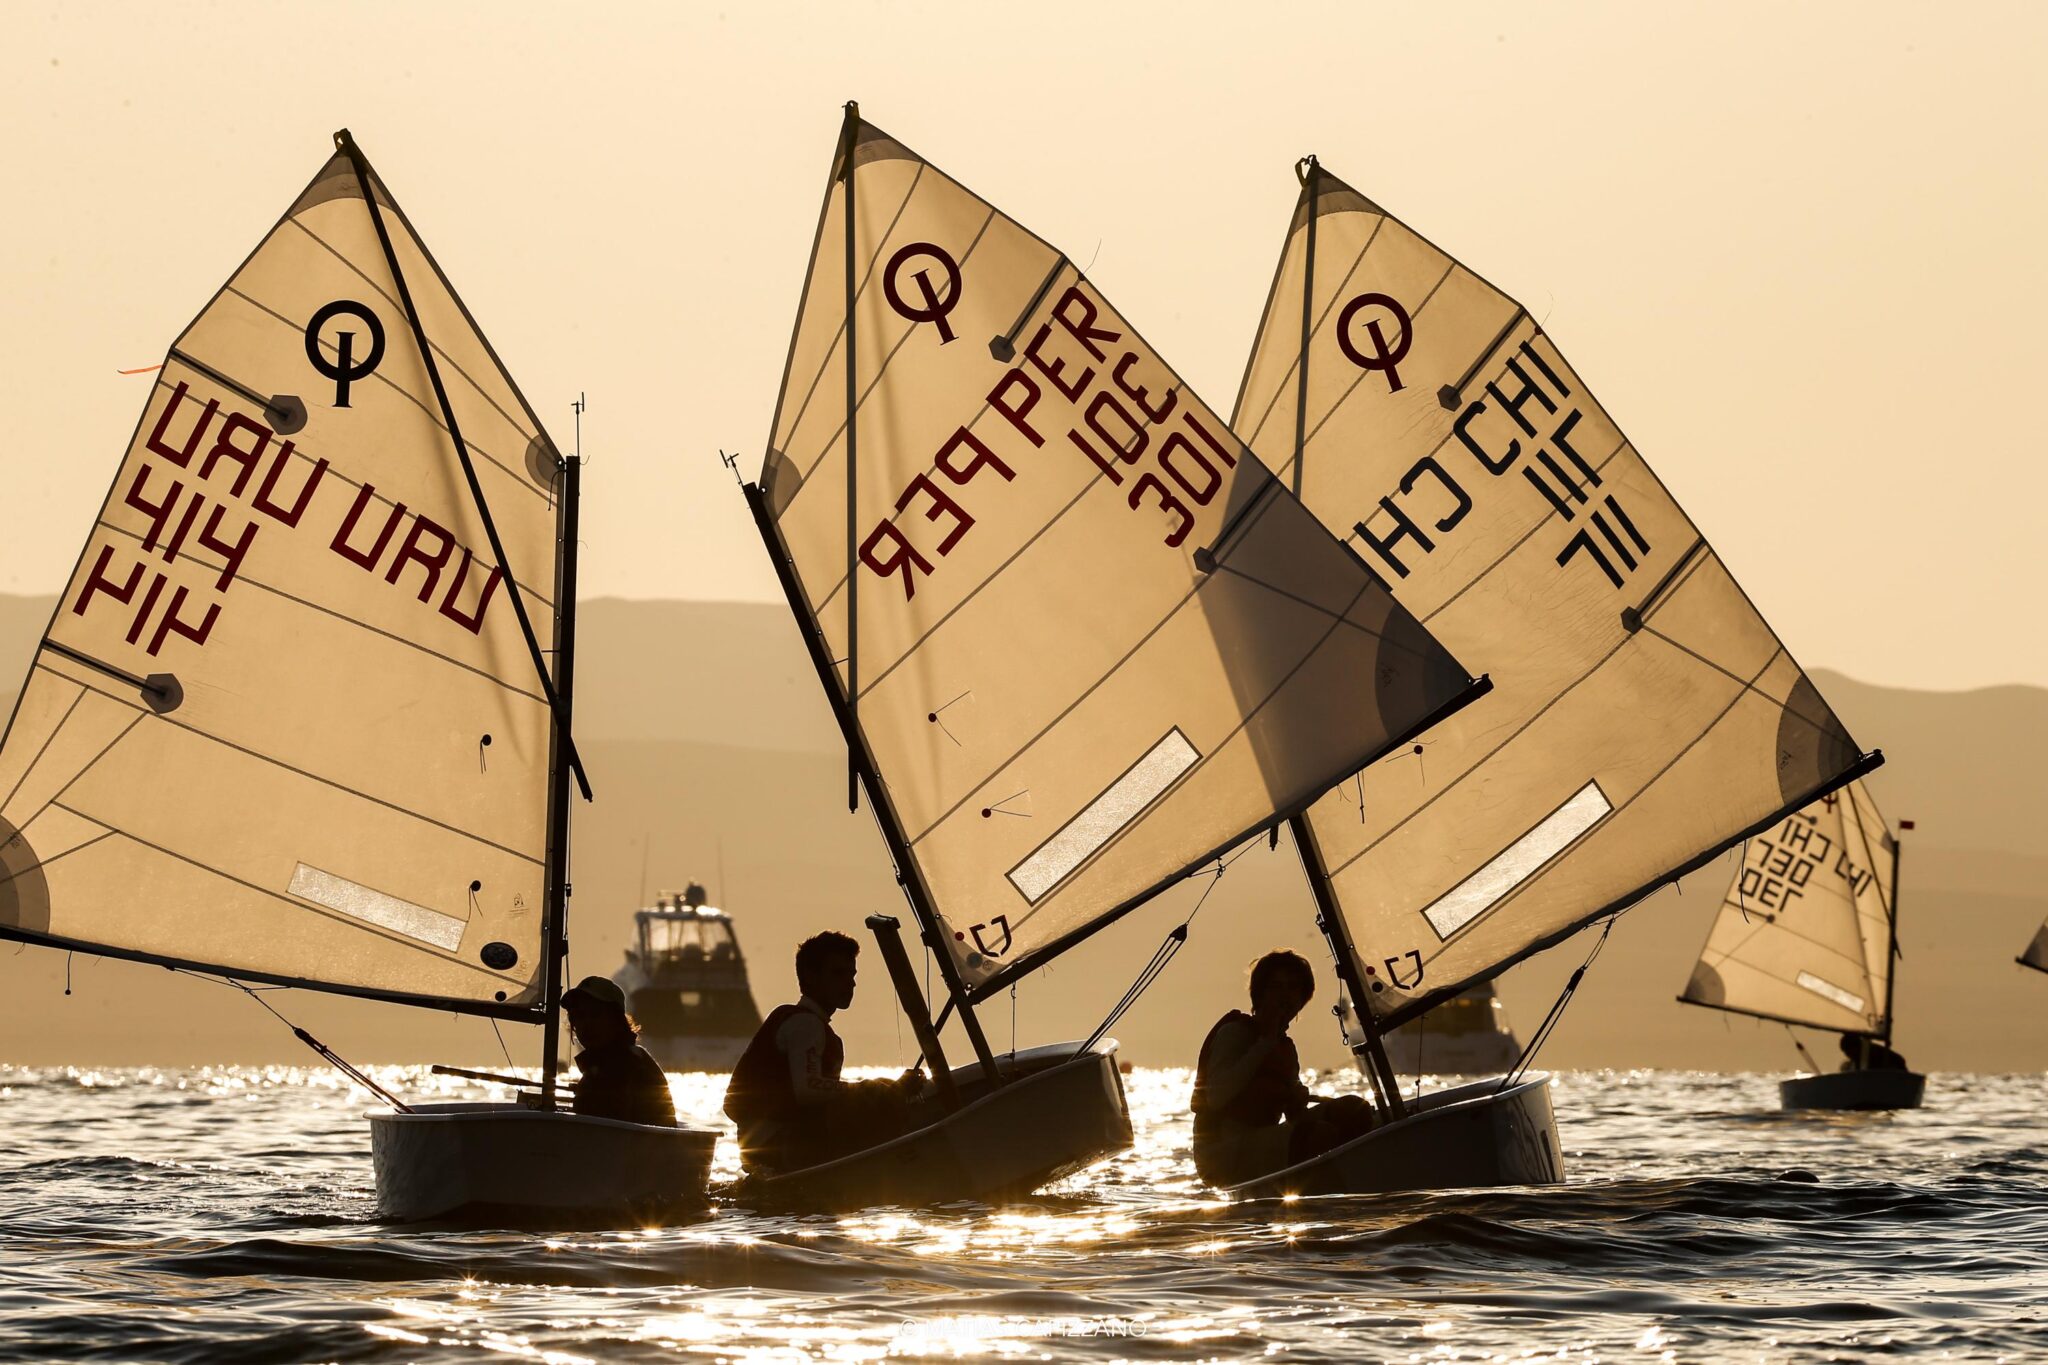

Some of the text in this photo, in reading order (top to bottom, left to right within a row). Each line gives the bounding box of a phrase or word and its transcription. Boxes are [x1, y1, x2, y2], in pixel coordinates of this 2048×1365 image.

[986, 286, 1122, 449] PER
[1452, 340, 1571, 476] CHI
[124, 463, 260, 593] 414
[1128, 411, 1237, 548] 301
[1555, 494, 1651, 590] 711
[329, 483, 502, 635] URU
[1758, 838, 1815, 888] 730
